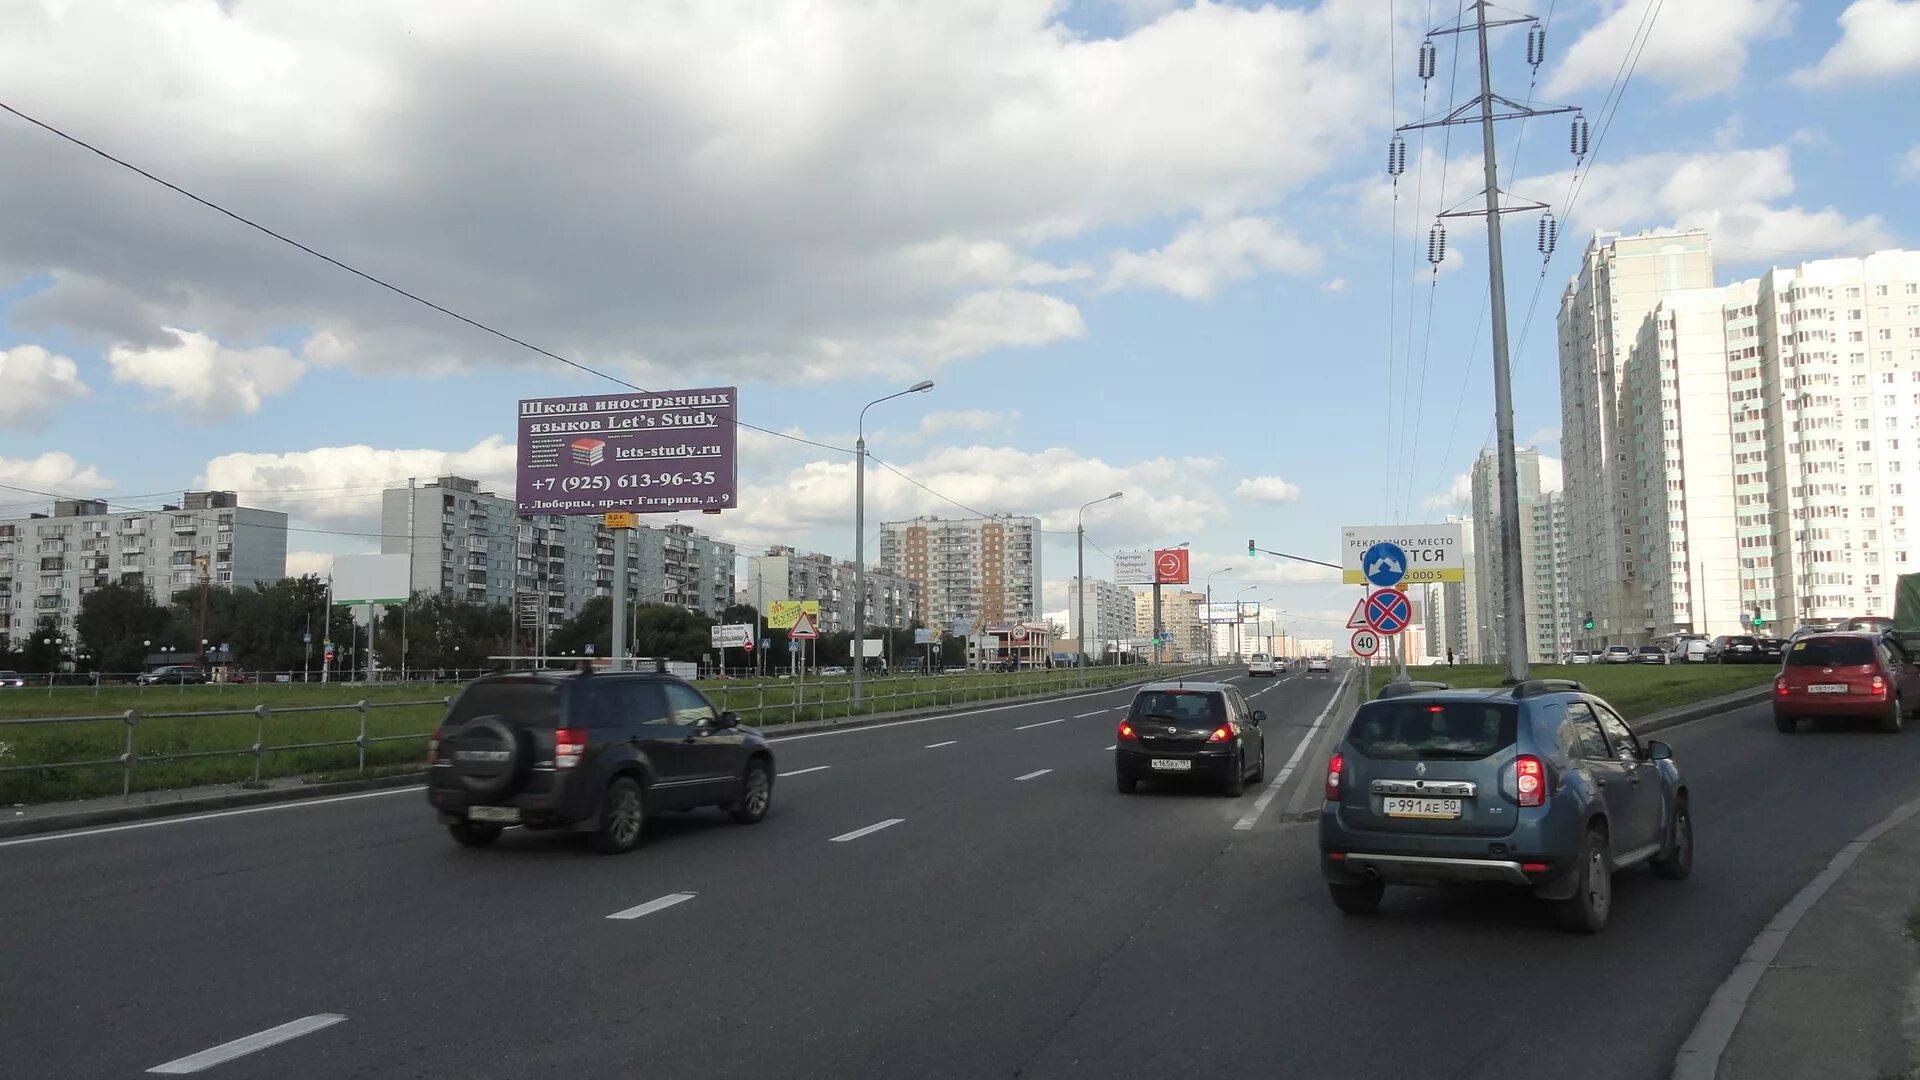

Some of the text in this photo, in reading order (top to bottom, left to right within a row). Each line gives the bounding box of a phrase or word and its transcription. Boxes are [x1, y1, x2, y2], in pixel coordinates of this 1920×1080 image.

[521, 394, 729, 416] Школа иностранных
[530, 418, 601, 433] языков
[661, 411, 718, 427] Study
[616, 443, 721, 459] lets-study.ru
[531, 471, 716, 493] +7 (925) 613-96-35
[519, 493, 730, 510] г. Люберцы, пр-кт Гагарина, д. 9
[1417, 537, 1453, 546] МЕСТО
[1412, 571, 1433, 580] 000
[1014, 628, 1024, 636] 20
[1357, 636, 1373, 649] 40
[1374, 785, 1470, 794] DUSTER
[1443, 800, 1457, 810] 50
